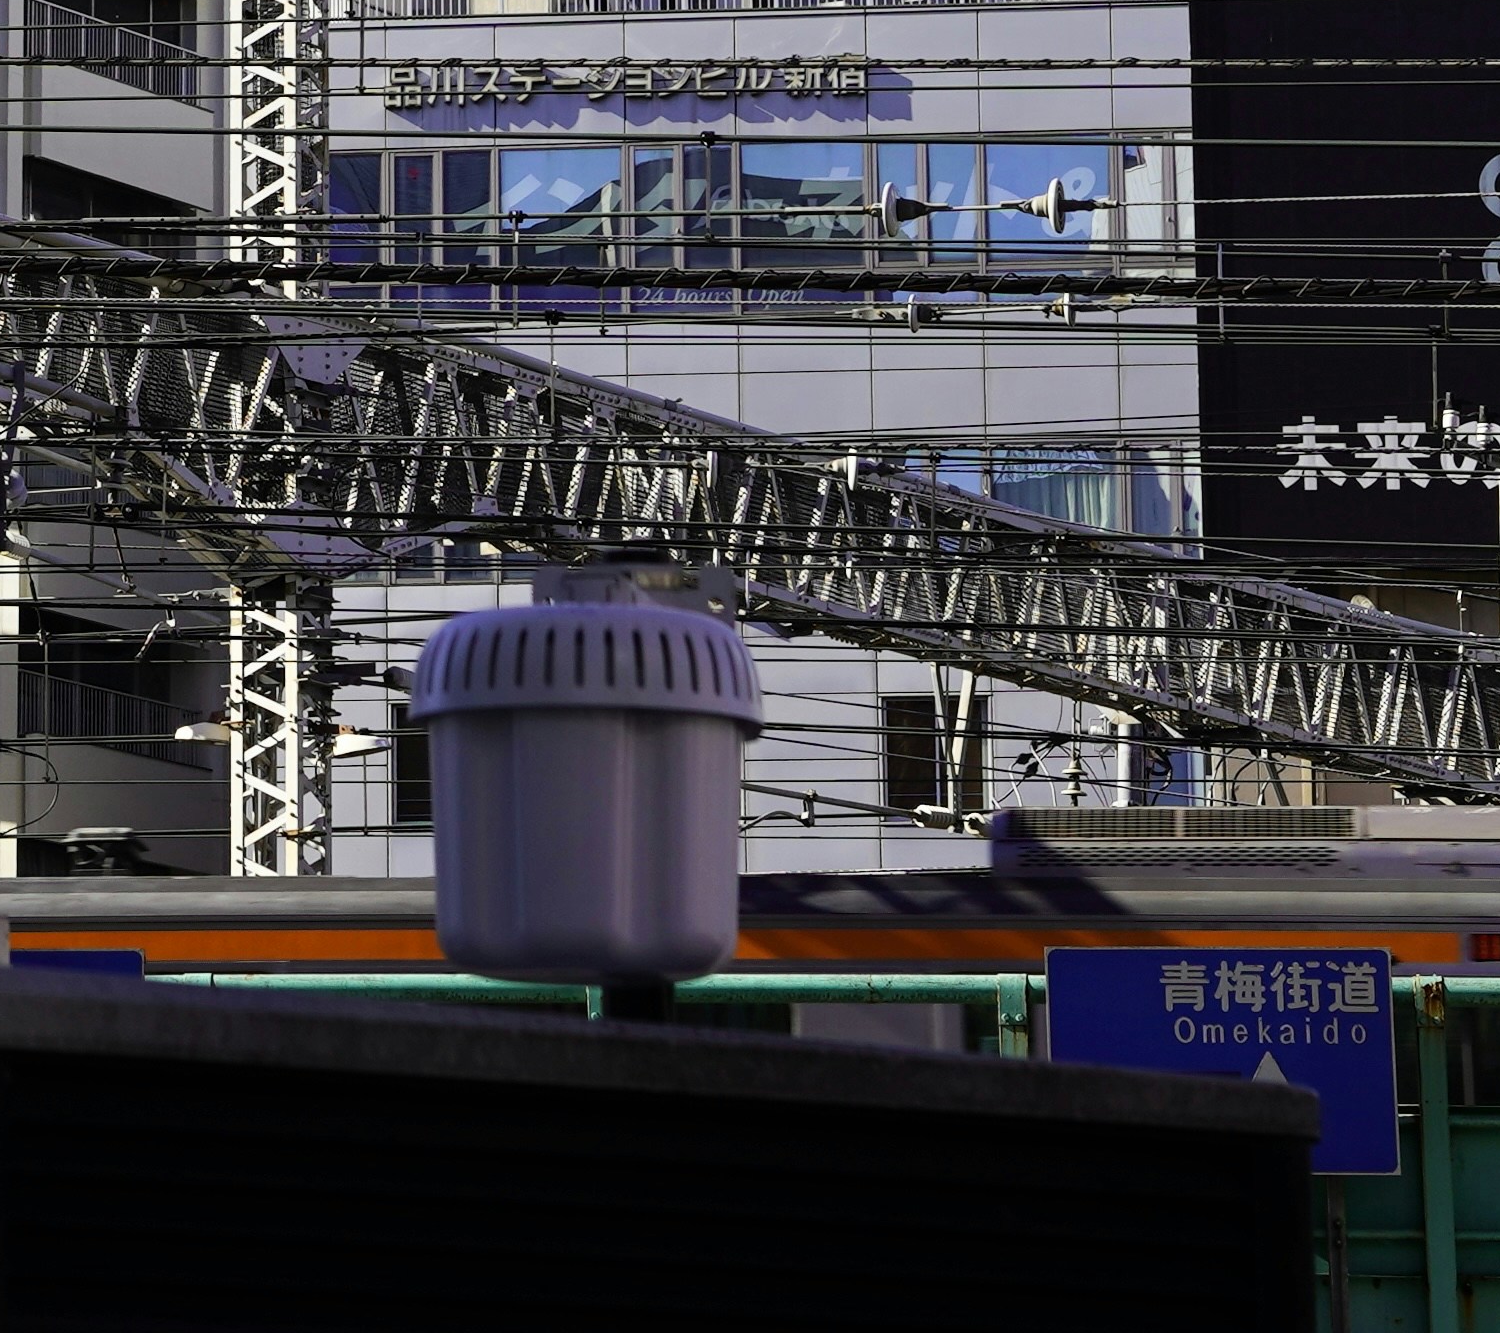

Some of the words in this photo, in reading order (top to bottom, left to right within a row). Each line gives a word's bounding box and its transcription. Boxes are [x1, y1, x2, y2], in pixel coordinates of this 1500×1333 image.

[1159, 960, 1380, 1013] 青梅街道
[1174, 1017, 1367, 1045] Omekaido
